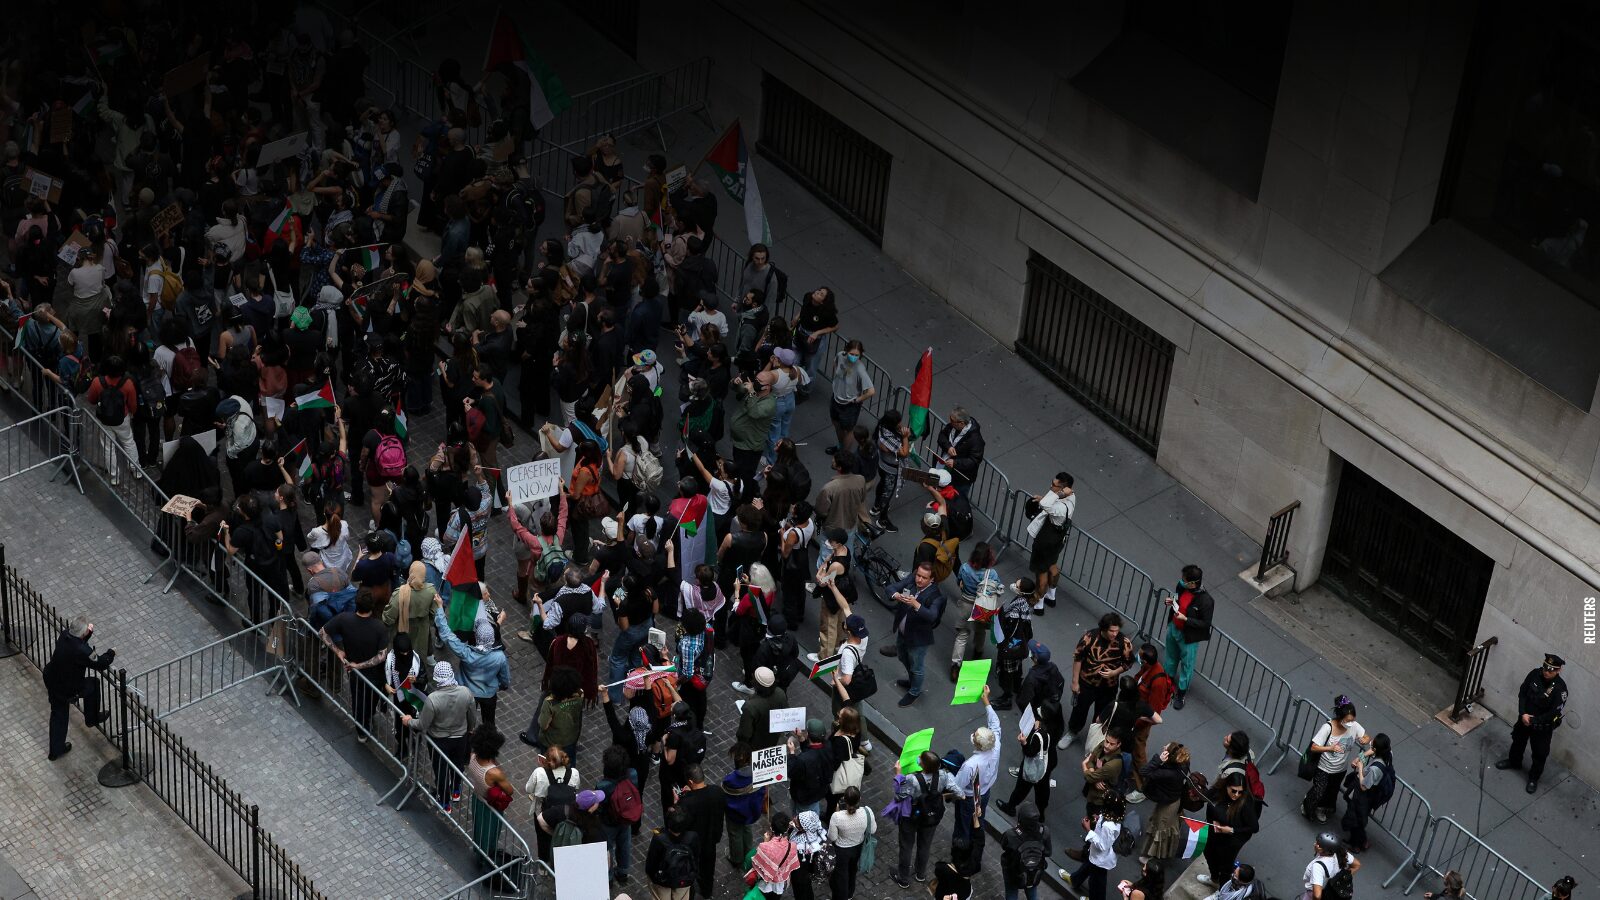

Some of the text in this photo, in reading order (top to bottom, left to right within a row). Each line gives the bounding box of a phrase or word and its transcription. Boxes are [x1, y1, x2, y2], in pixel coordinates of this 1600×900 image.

[510, 462, 558, 483] CEASEFIRE
[518, 478, 553, 499] NOW
[757, 747, 782, 760] FREE
[753, 755, 787, 771] MASKS!
